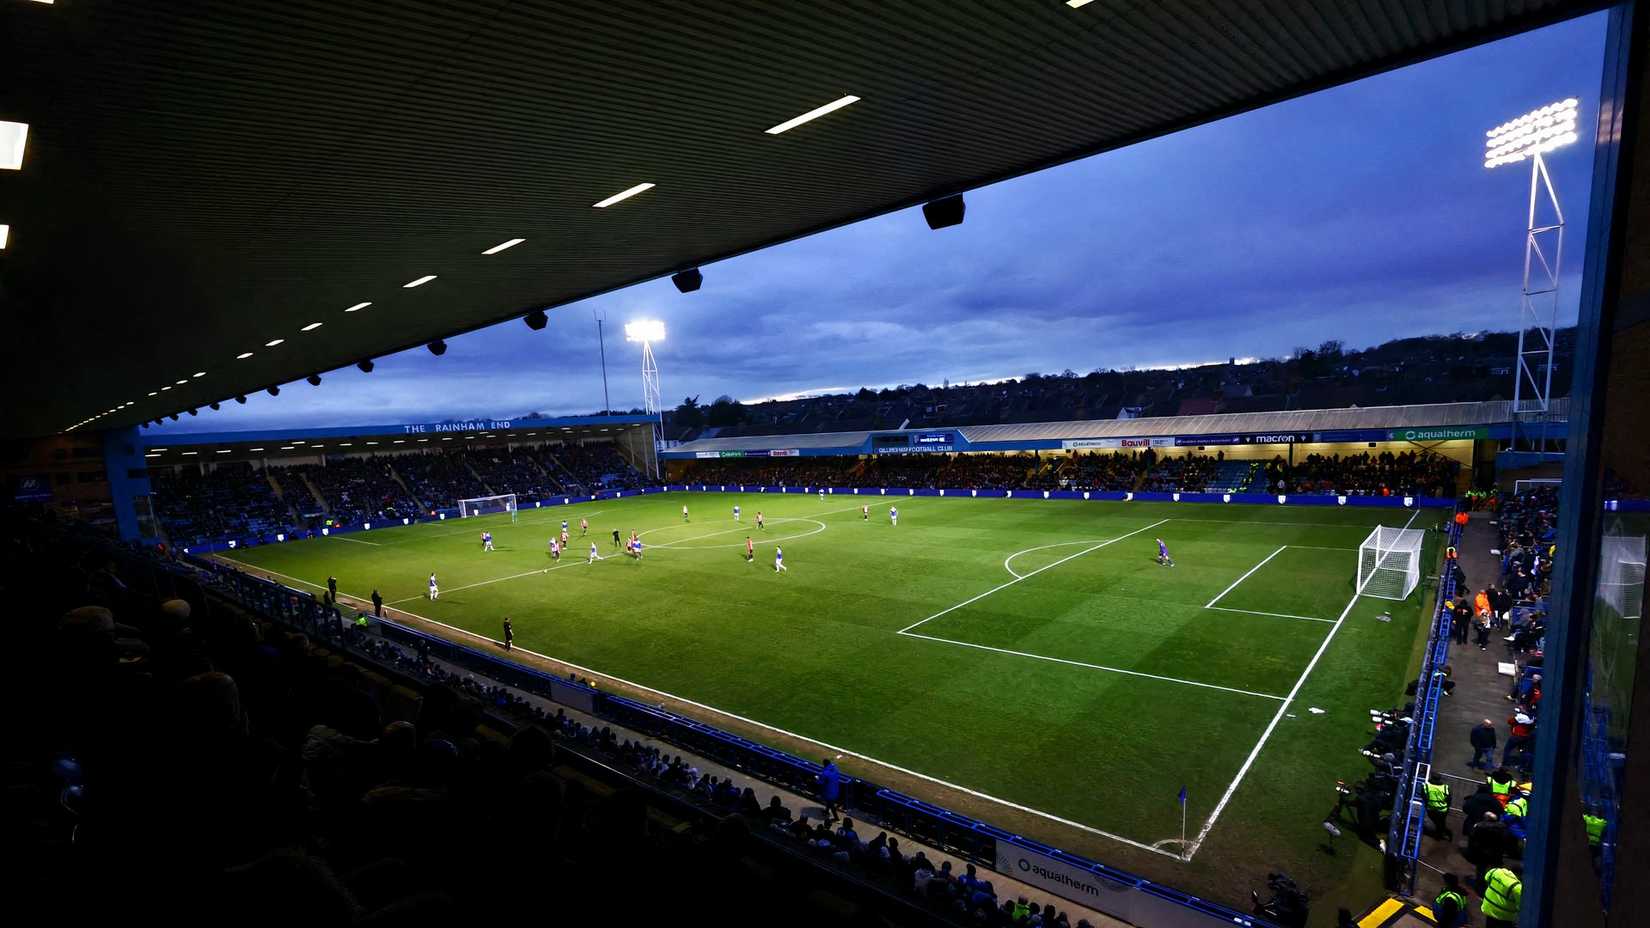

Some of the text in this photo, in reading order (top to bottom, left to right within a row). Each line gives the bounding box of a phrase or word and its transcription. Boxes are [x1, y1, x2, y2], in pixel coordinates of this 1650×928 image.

[404, 421, 511, 433] THE RAINHAM END
[1256, 435, 1295, 443] macron
[1417, 430, 1475, 440] aquatherm
[1121, 439, 1151, 447] Bauvill
[1032, 864, 1099, 896] aquatherm
